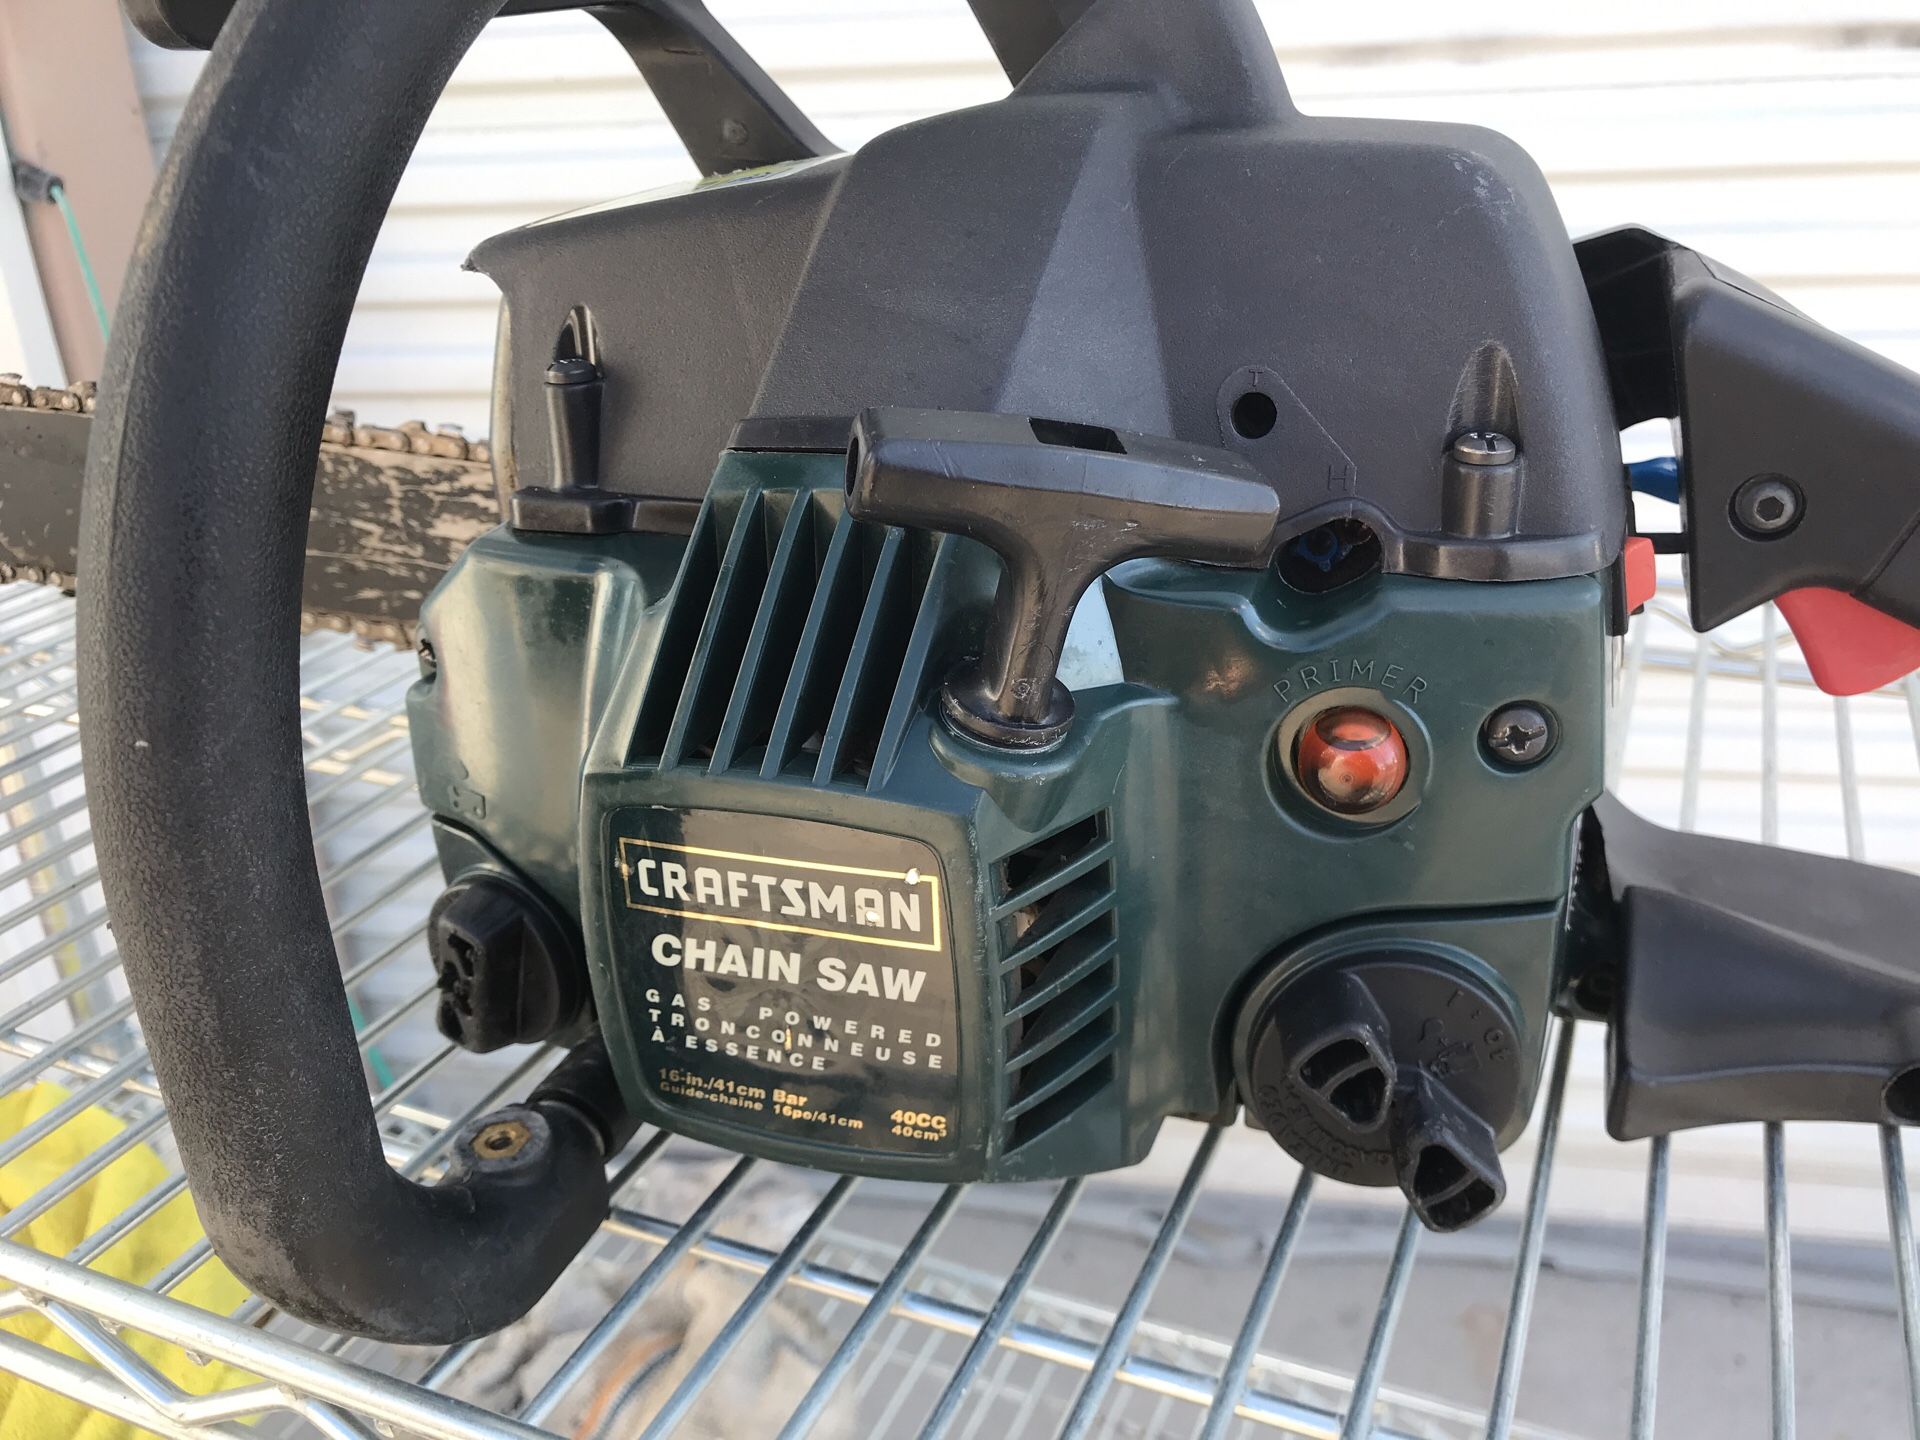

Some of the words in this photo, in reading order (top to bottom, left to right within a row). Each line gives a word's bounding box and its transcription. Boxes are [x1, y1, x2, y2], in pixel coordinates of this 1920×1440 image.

[1248, 369, 1263, 388] T
[1327, 465, 1348, 491] H
[1273, 659, 1427, 703] PRIMER
[637, 858, 921, 932] CRAFTSMAN
[651, 933, 801, 985] CHAIN
[816, 957, 927, 1003] SAW
[645, 988, 711, 1011] GAS
[759, 1006, 942, 1048] POWERED
[651, 1025, 665, 1043] À
[685, 1034, 825, 1071] ESSENCE
[659, 1067, 766, 1100] 16-in./41cm
[772, 1088, 808, 1107] Bar
[773, 1103, 864, 1130] 16po/41cm
[890, 1109, 947, 1130] 40CC
